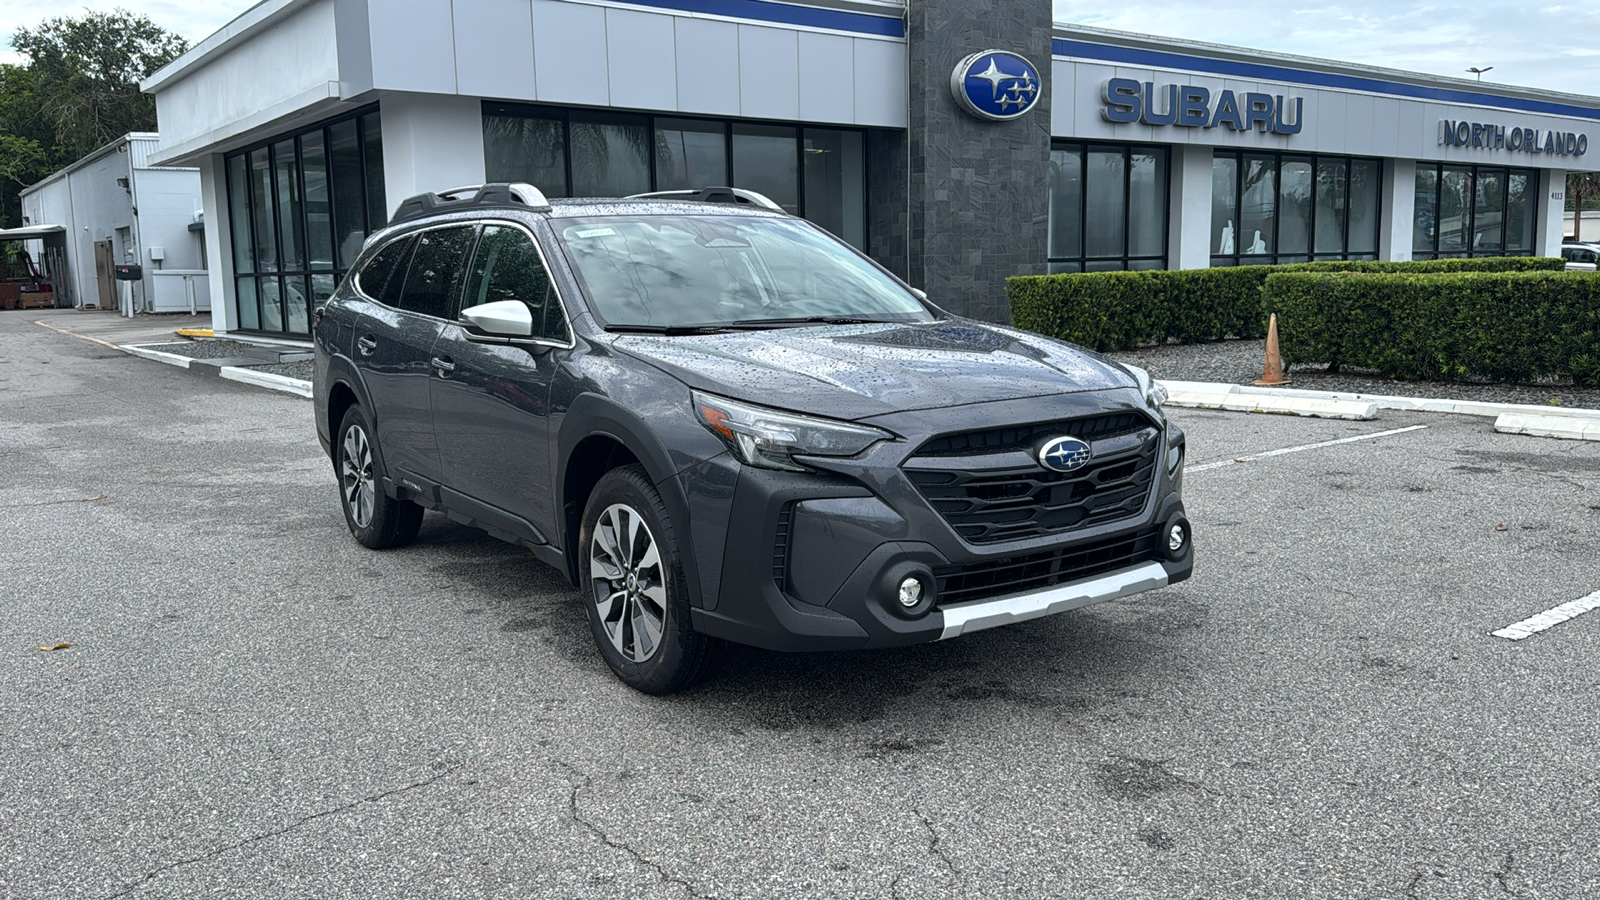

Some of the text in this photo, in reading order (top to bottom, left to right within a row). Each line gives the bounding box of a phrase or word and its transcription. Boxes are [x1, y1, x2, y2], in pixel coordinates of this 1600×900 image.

[1100, 77, 1304, 135] SUBARU
[1439, 119, 1588, 156] NORTH ORLANDO
[1551, 191, 1563, 200] 4113
